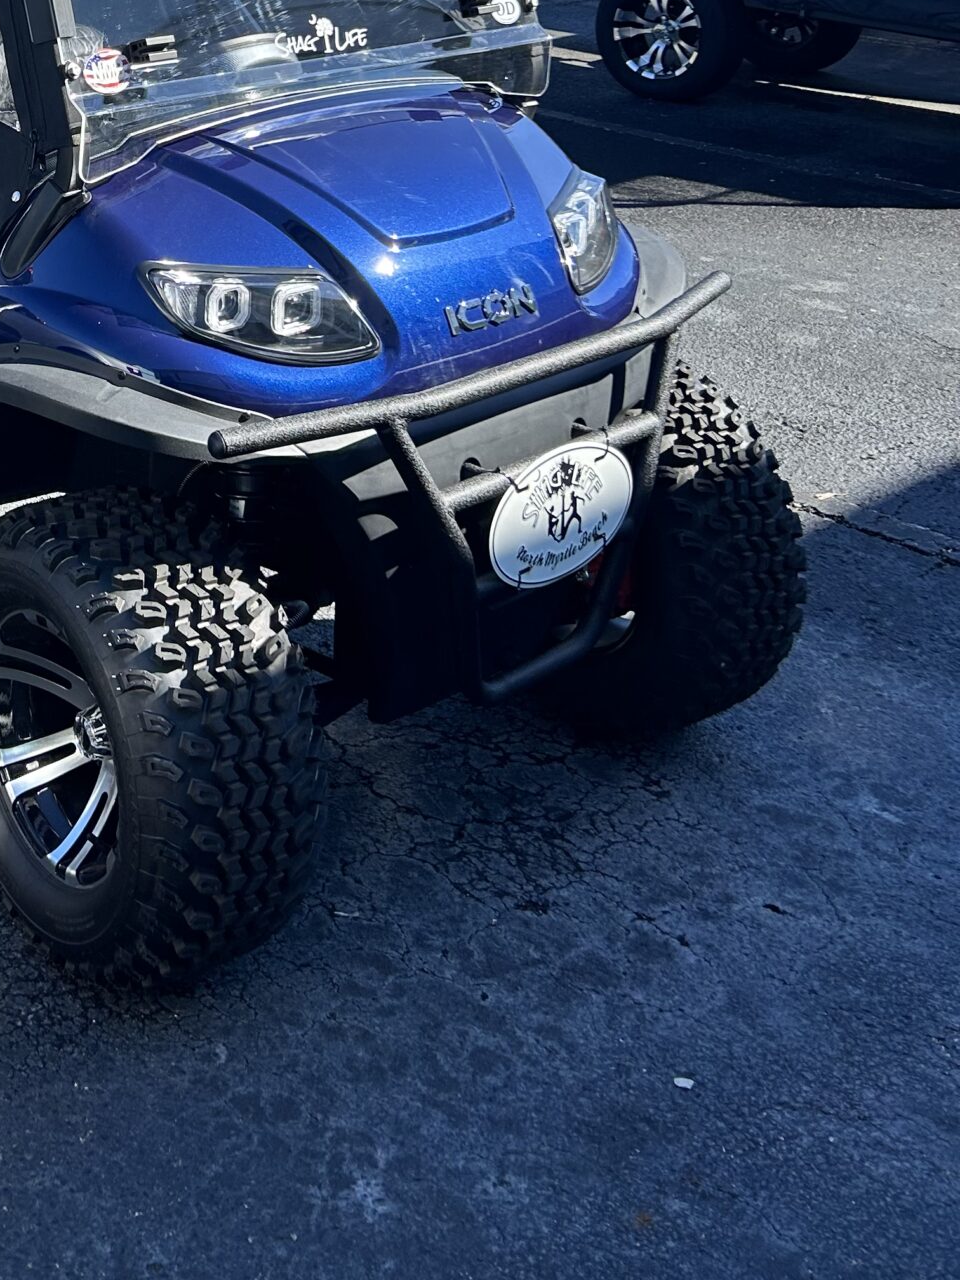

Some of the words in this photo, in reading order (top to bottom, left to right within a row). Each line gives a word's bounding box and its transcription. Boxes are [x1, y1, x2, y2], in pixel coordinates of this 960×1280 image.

[274, 32, 320, 58] SHAG
[334, 27, 368, 51] LIFE
[443, 285, 537, 337] ICON
[516, 545, 544, 566] North
[544, 544, 577, 570] Myrtle
[578, 511, 608, 551] Beach
